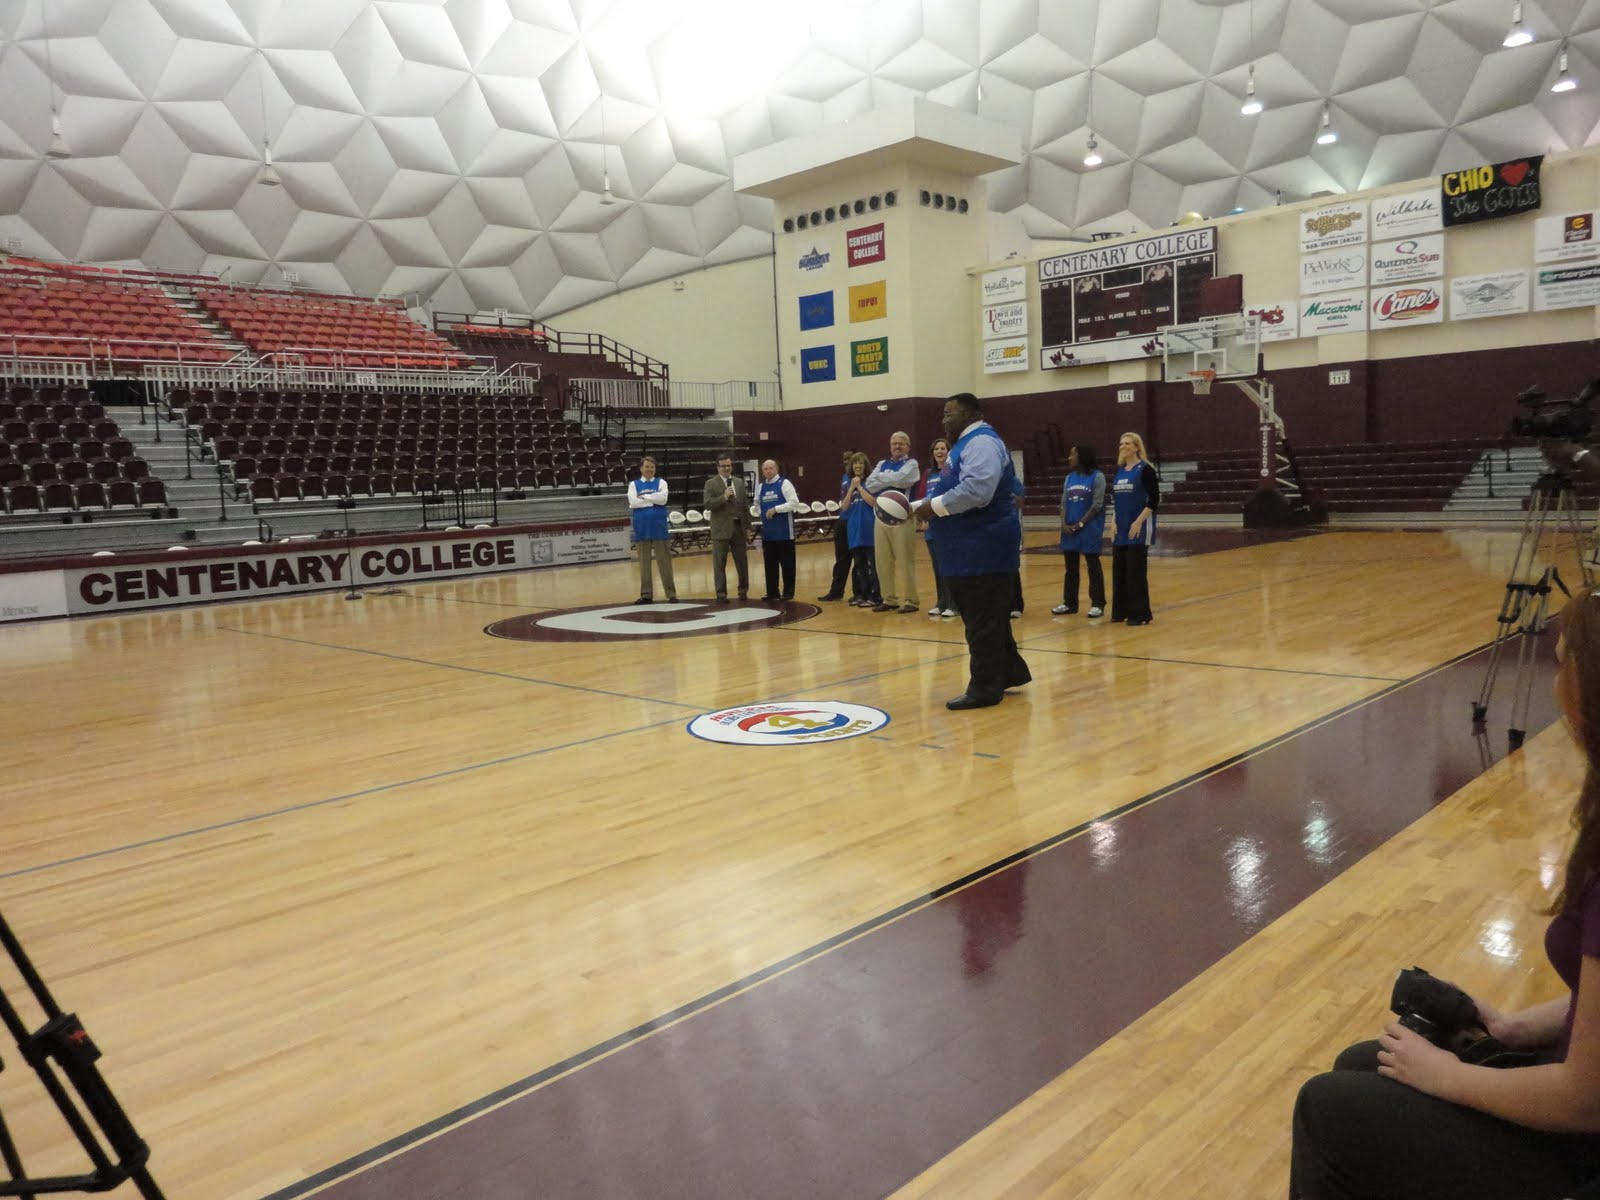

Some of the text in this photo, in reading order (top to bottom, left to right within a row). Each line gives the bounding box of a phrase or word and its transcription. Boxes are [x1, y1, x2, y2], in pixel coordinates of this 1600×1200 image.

[1444, 165, 1494, 196] CHIO
[849, 231, 883, 248] CENTENARY
[854, 245, 880, 259] COLLEGE
[1043, 246, 1129, 277] CENTENARY
[1135, 231, 1209, 260] COLLEGE
[985, 309, 1009, 323] Town
[1010, 306, 1023, 316] and
[1303, 300, 1364, 318] Macaroni
[991, 318, 1023, 333] Country
[857, 342, 881, 353] NORTH
[986, 345, 1026, 361] SUBWAY
[856, 352, 883, 364] DAKOTA
[859, 362, 881, 373] STATE
[358, 376, 373, 384] 102
[1333, 375, 1347, 384] 113
[80, 540, 516, 605] CENTENARY COLLEGE
[767, 715, 833, 729] 4
